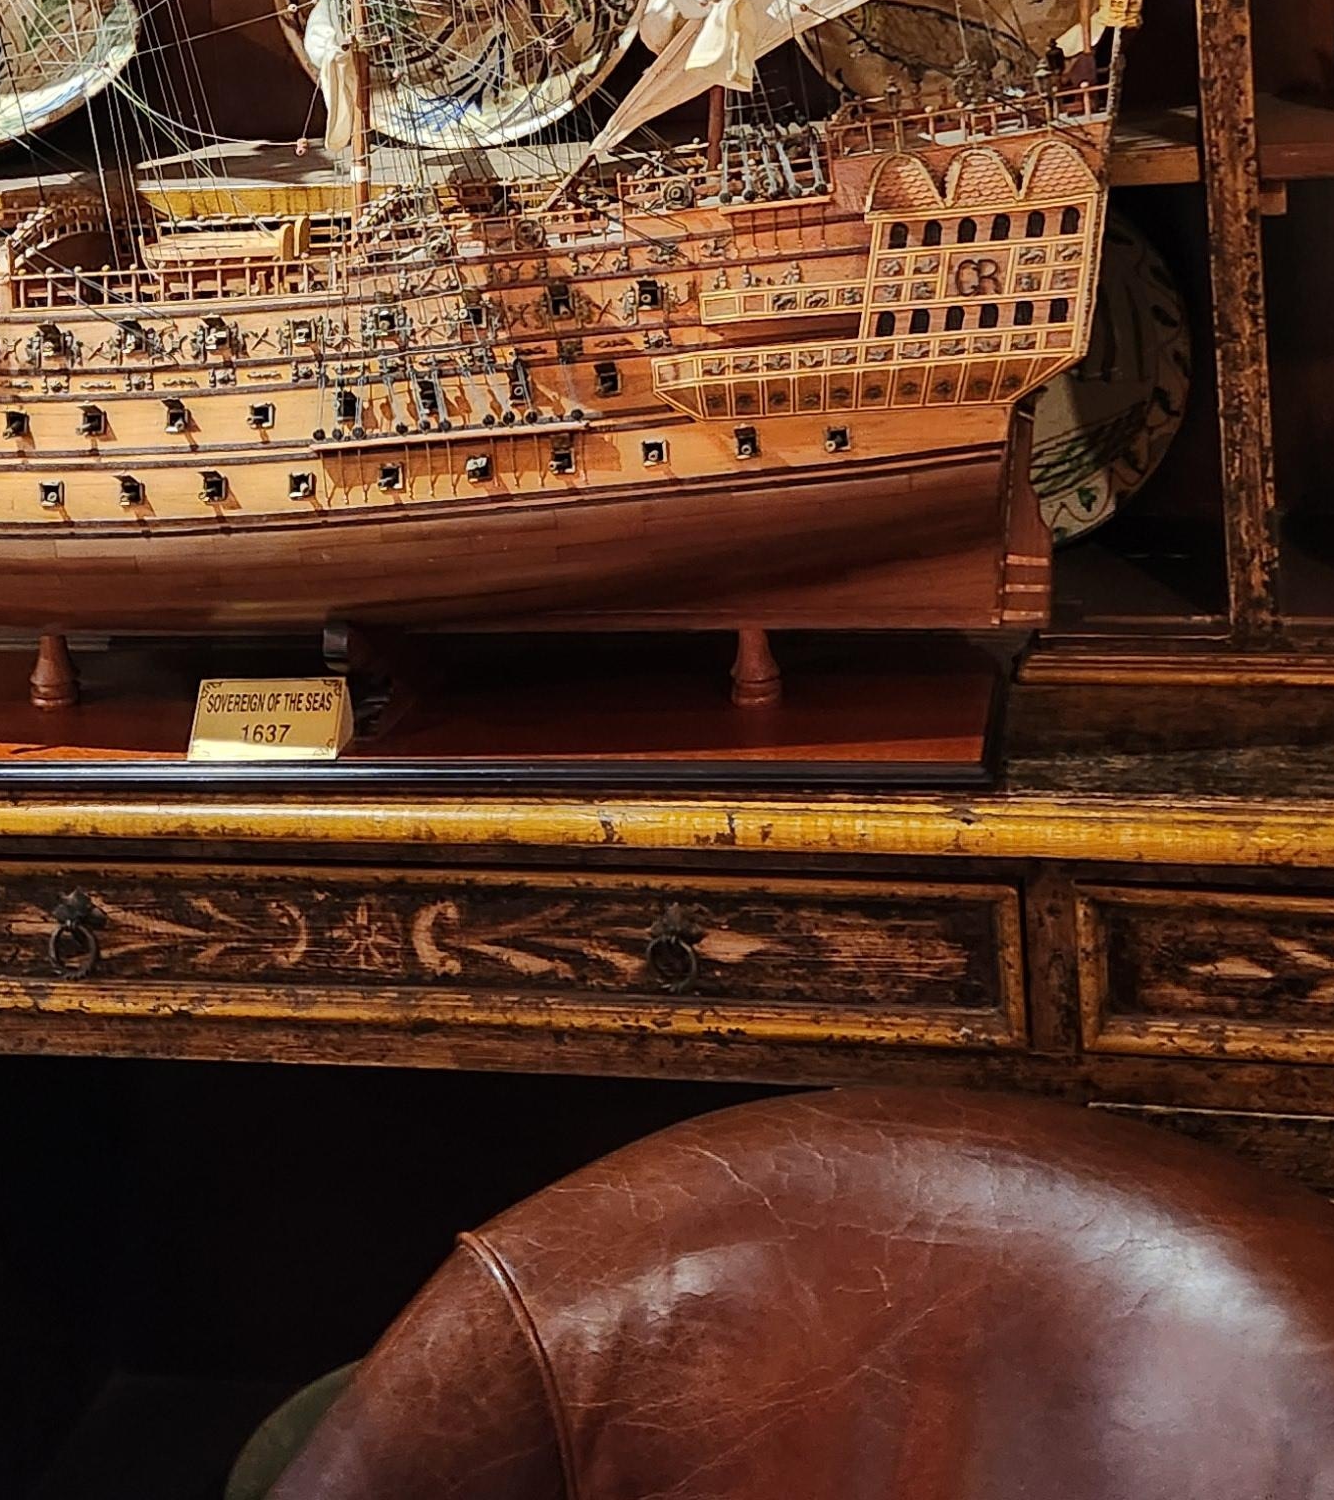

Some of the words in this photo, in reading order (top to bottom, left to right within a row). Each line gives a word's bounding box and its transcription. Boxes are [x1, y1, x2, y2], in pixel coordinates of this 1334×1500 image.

[207, 693, 265, 713] SOVEREIGN
[267, 693, 282, 712] OF
[284, 693, 303, 712] THE
[306, 692, 333, 712] SEAS
[241, 724, 292, 743] 1637
